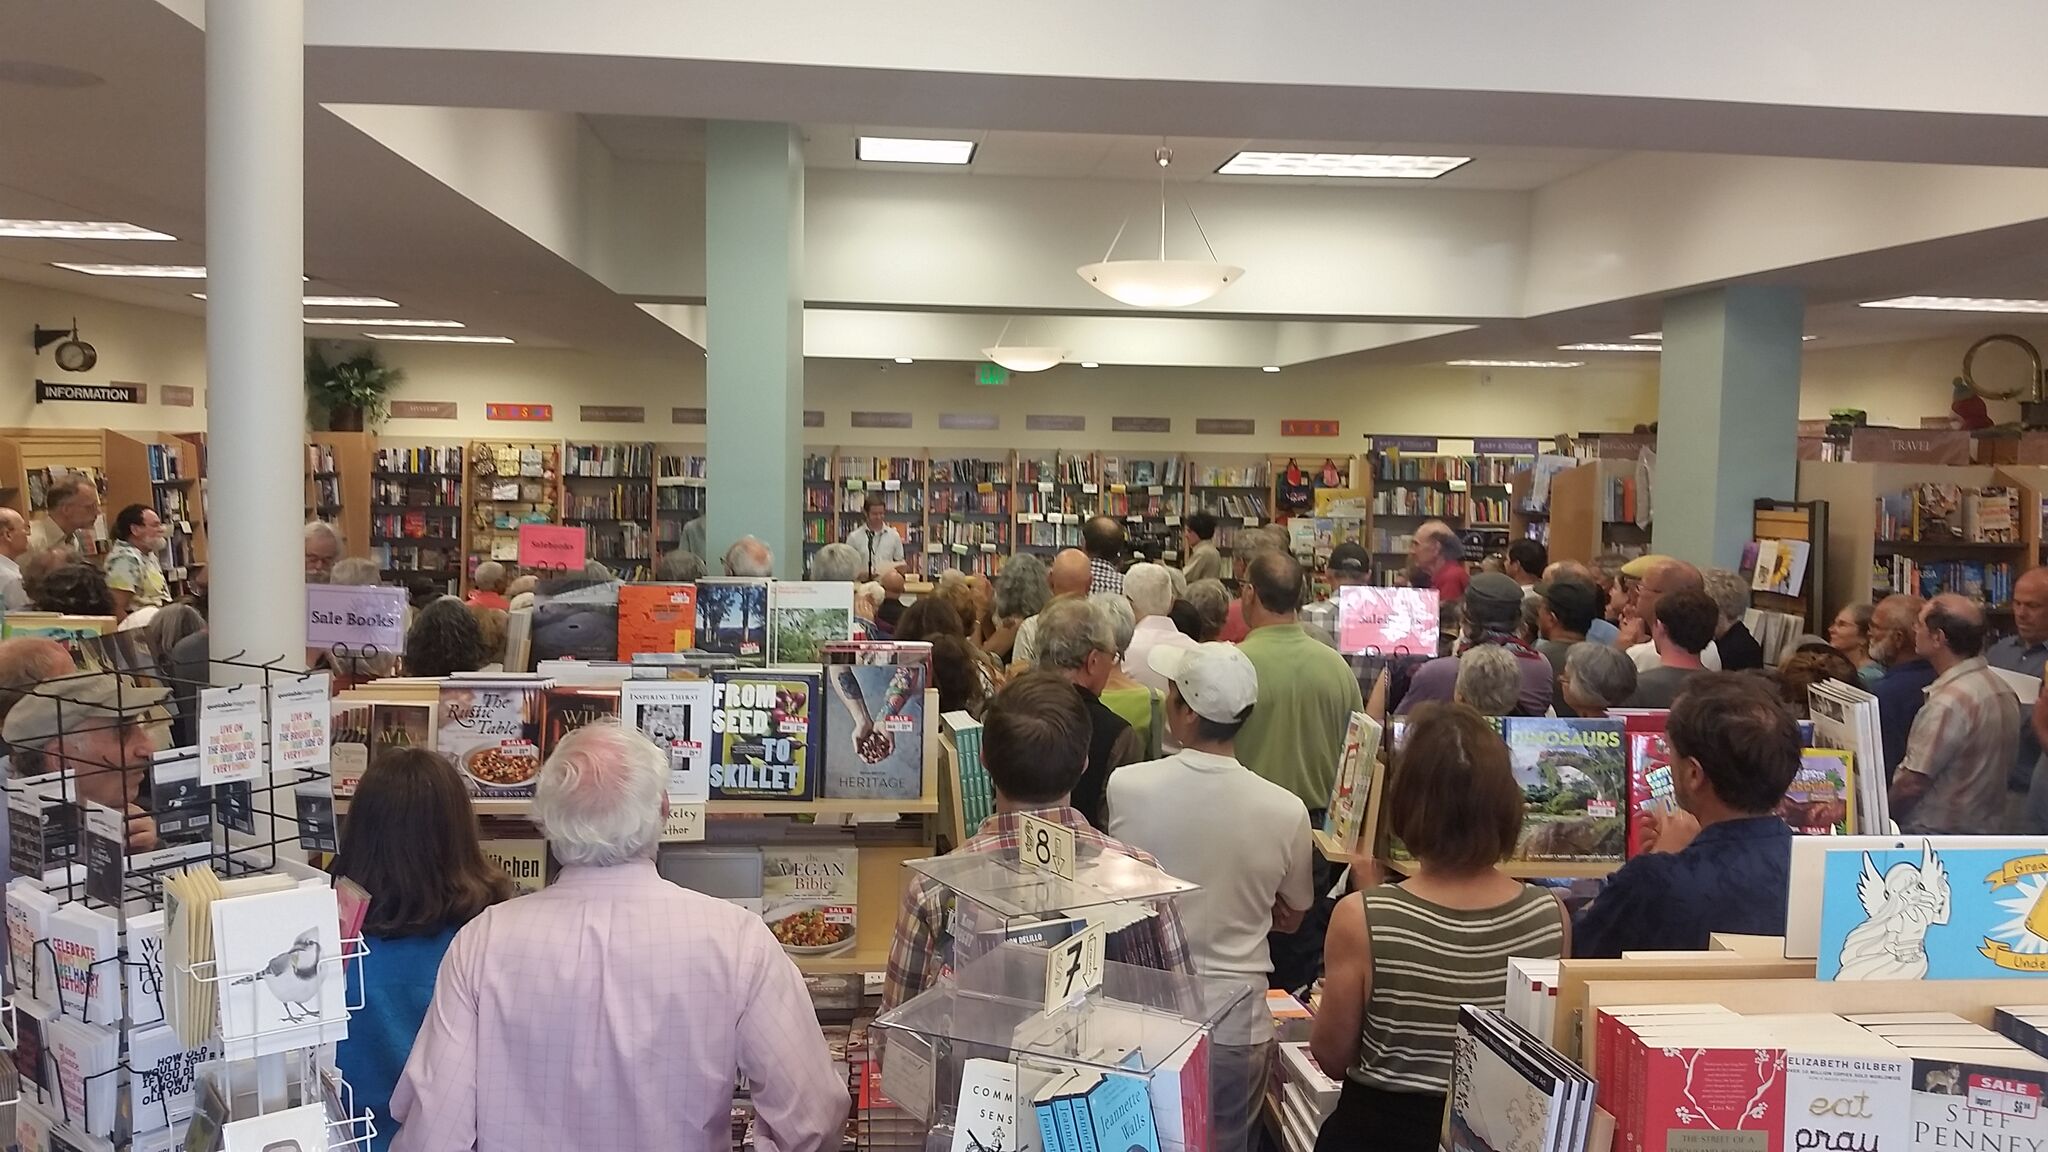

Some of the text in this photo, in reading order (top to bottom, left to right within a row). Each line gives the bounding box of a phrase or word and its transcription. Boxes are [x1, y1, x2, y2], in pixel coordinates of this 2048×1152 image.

[45, 386, 129, 401] INFORMATION
[1891, 440, 1929, 450] TRAVEL
[311, 610, 395, 627] Sale Books
[483, 693, 512, 709] The
[713, 683, 777, 708] FROM
[448, 704, 494, 728] Rustic
[712, 709, 768, 734] SEED
[479, 719, 519, 735] Table
[1511, 731, 1620, 748] DINOSAURS
[762, 738, 791, 762] TO
[709, 763, 798, 788] SKILLET
[839, 777, 905, 789] HERITAGE
[667, 808, 697, 821] keley
[488, 854, 539, 878] tchen
[806, 853, 818, 862] the
[779, 863, 844, 876] VEGAN
[2014, 860, 2048, 874] Grea
[795, 877, 831, 890] Bible
[1018, 933, 1043, 944] DELILLO
[53, 937, 96, 961] CELEBRATE
[1063, 940, 1083, 998] 7
[2013, 956, 2048, 968] Unde
[60, 976, 98, 998] IRTHDAY!
[157, 1052, 183, 1067] HOW
[185, 1054, 206, 1067] YOU
[1788, 1056, 1902, 1072] ELIZABETH GILBERT
[142, 1062, 181, 1079] WOULD
[143, 1077, 155, 1088] IF
[151, 1077, 183, 1093] KNOW
[168, 1084, 189, 1097] YOU
[1980, 1077, 2028, 1094] SALE
[1809, 1089, 1873, 1119] eat
[980, 1109, 1014, 1125] SENS
[1100, 1091, 1143, 1136] Jeannette
[1946, 1104, 2010, 1129] STEF
[1039, 1112, 1057, 1152] Jeannet
[1059, 1107, 1077, 1152] Jeannett
[1121, 1113, 1146, 1141] Walls
[1795, 1128, 1880, 1152] pray
[1915, 1121, 2044, 1152] PENNEY
